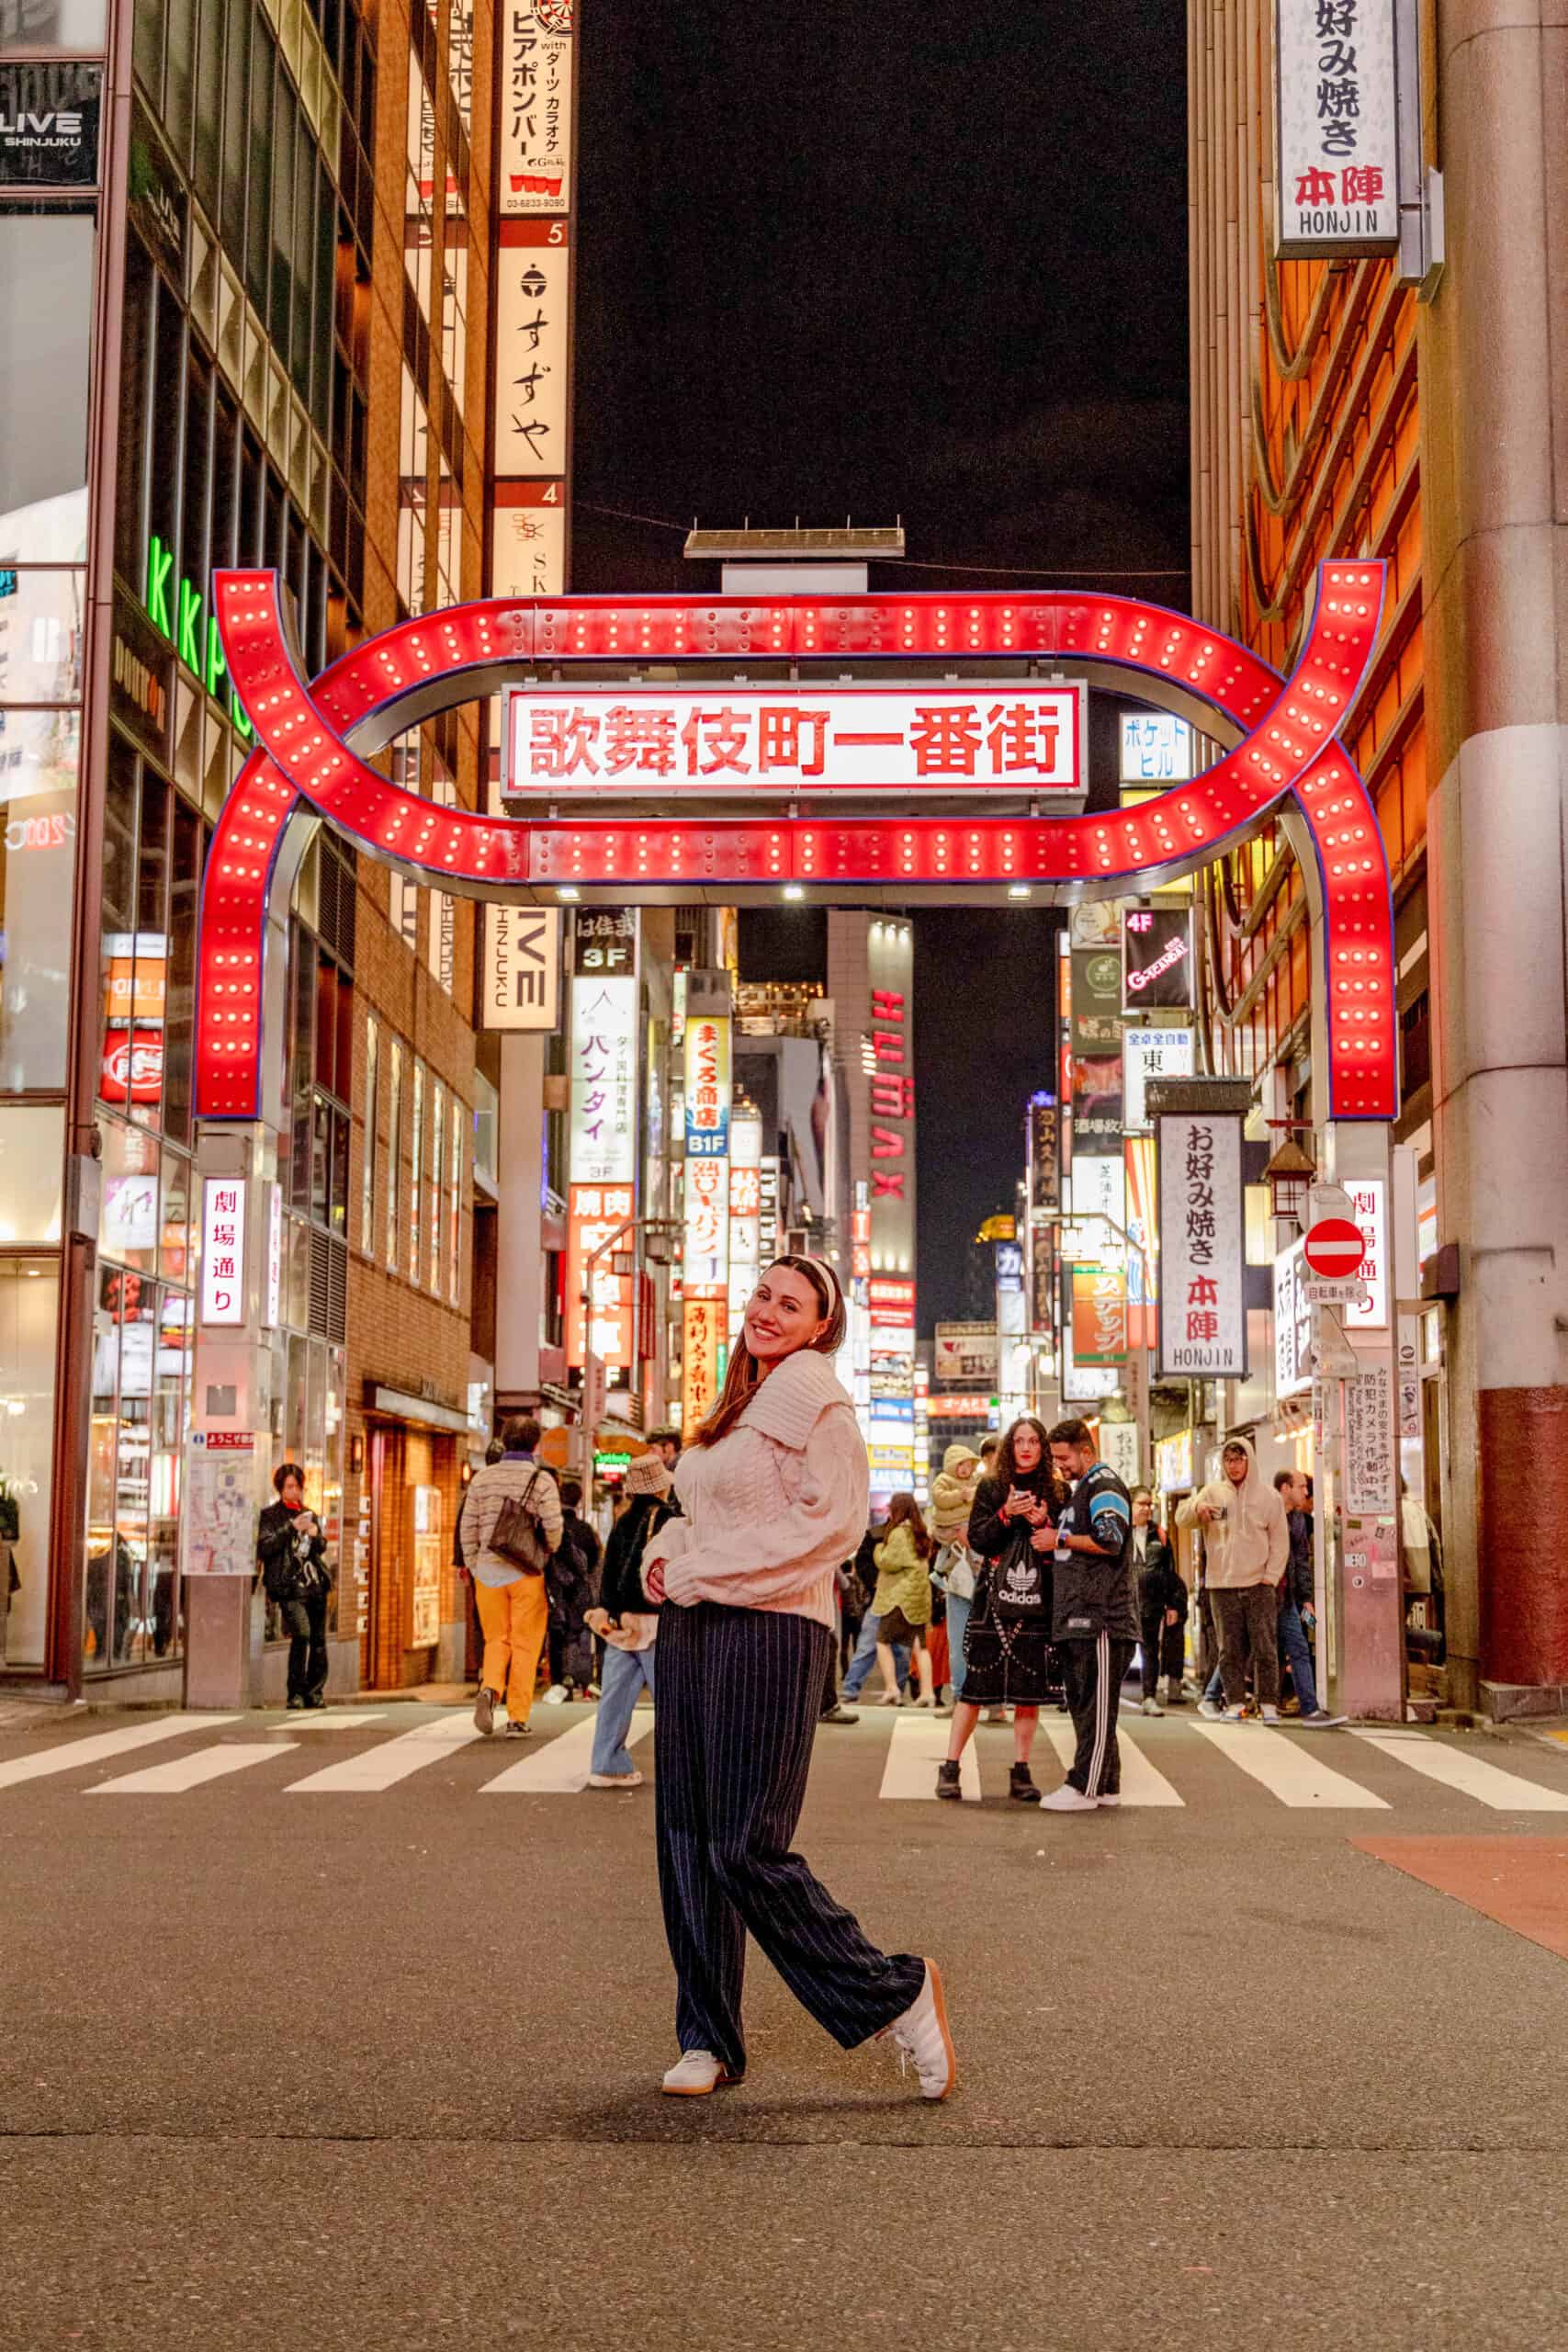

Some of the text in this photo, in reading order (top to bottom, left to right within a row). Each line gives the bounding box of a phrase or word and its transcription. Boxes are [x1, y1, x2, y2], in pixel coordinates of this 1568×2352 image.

[541, 41, 567, 51] with
[546, 51, 560, 153] ダーツ カラオケ
[5, 137, 82, 147] SHINJUKU
[1295, 165, 1384, 207] 本陣
[548, 224, 564, 243] 5
[1300, 209, 1379, 235] HONJIN
[510, 308, 552, 460] すずや
[543, 484, 558, 503] 4
[529, 704, 1059, 776] 歌舞伎町一番街
[1127, 912, 1154, 933] 4F
[496, 905, 508, 1008] HINJUKU
[583, 947, 627, 967] 3F
[688, 1136, 726, 1154] B1F
[573, 1190, 633, 1217] 焼肉
[1186, 1125, 1216, 1265] お好み焼き
[213, 1191, 237, 1311] 劇場通り
[1309, 1286, 1363, 1301] 自転車を除く
[1186, 1274, 1219, 1343] 本陣
[1173, 1348, 1235, 1367] HONJIN
[998, 1589, 1043, 1605] adidas
